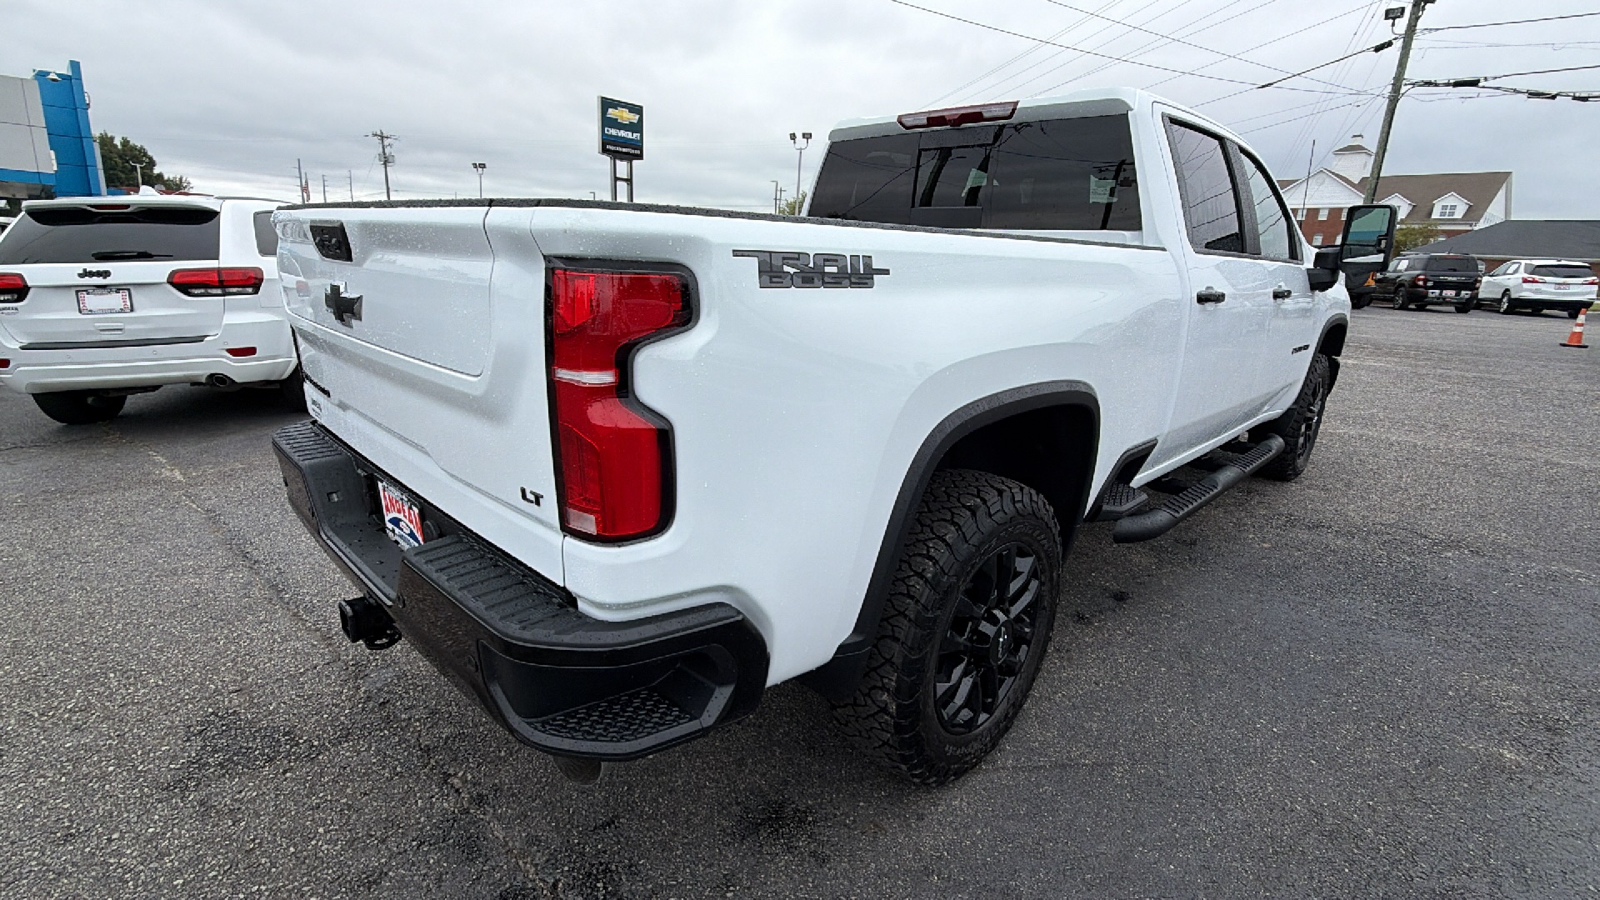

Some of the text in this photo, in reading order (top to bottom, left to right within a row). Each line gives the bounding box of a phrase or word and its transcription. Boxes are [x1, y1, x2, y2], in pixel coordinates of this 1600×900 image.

[604, 127, 641, 140] CHEVROLET
[732, 249, 890, 275] TRAIL
[77, 268, 111, 279] Jeep
[758, 272, 875, 289] BOSS
[520, 486, 544, 507] LT
